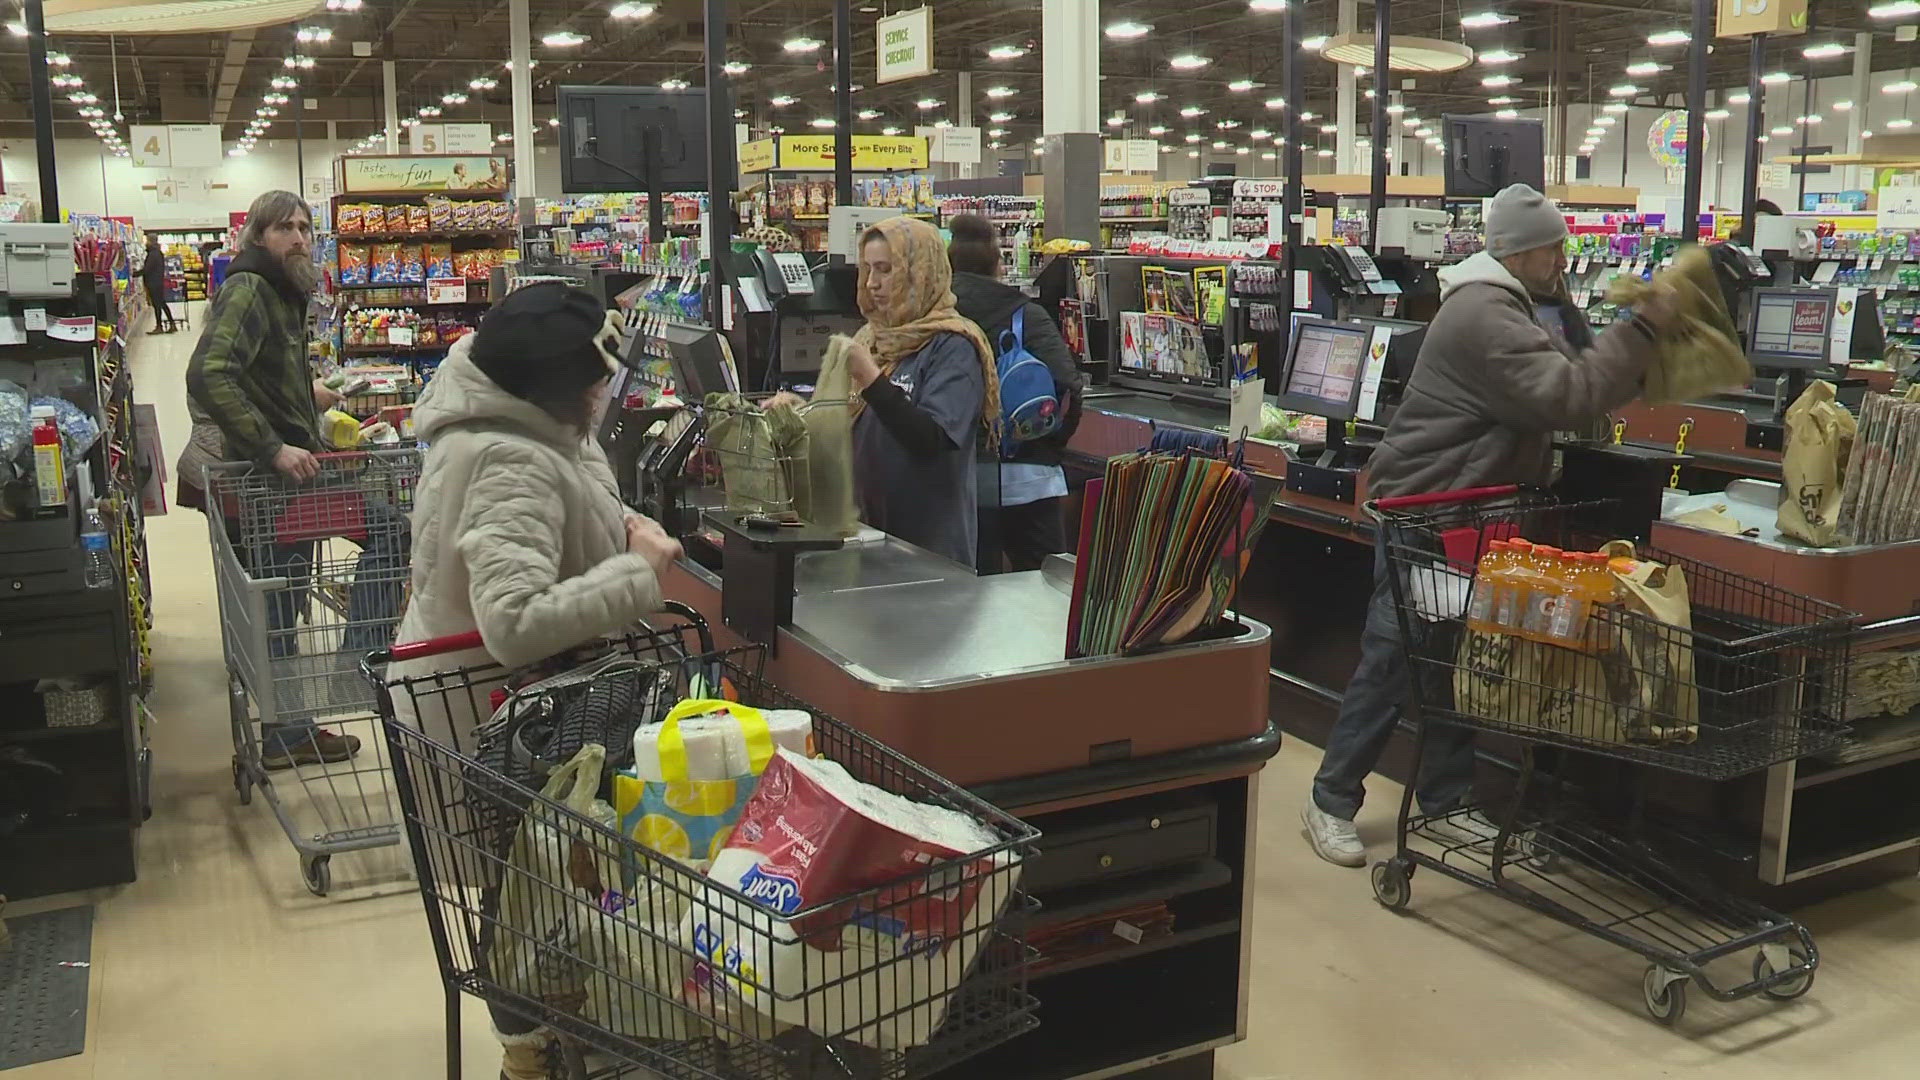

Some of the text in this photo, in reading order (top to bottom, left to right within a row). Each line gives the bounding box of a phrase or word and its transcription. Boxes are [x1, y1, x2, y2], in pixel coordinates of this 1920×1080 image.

[885, 27, 909, 46] SERVICE
[885, 46, 916, 66] CHECKOUT
[144, 135, 161, 156] 4
[422, 134, 437, 153] 5
[792, 143, 819, 153] More
[822, 143, 857, 153] Sns
[873, 144, 896, 155] Every
[898, 144, 913, 154] Bite
[357, 160, 386, 173] Taste
[400, 163, 433, 187] fun
[163, 186, 173, 197] 4
[312, 183, 321, 194] 5
[1254, 184, 1276, 193] STOP
[1199, 280, 1220, 289] MARY
[1795, 312, 1825, 326] team!
[743, 876, 795, 912] Scott
